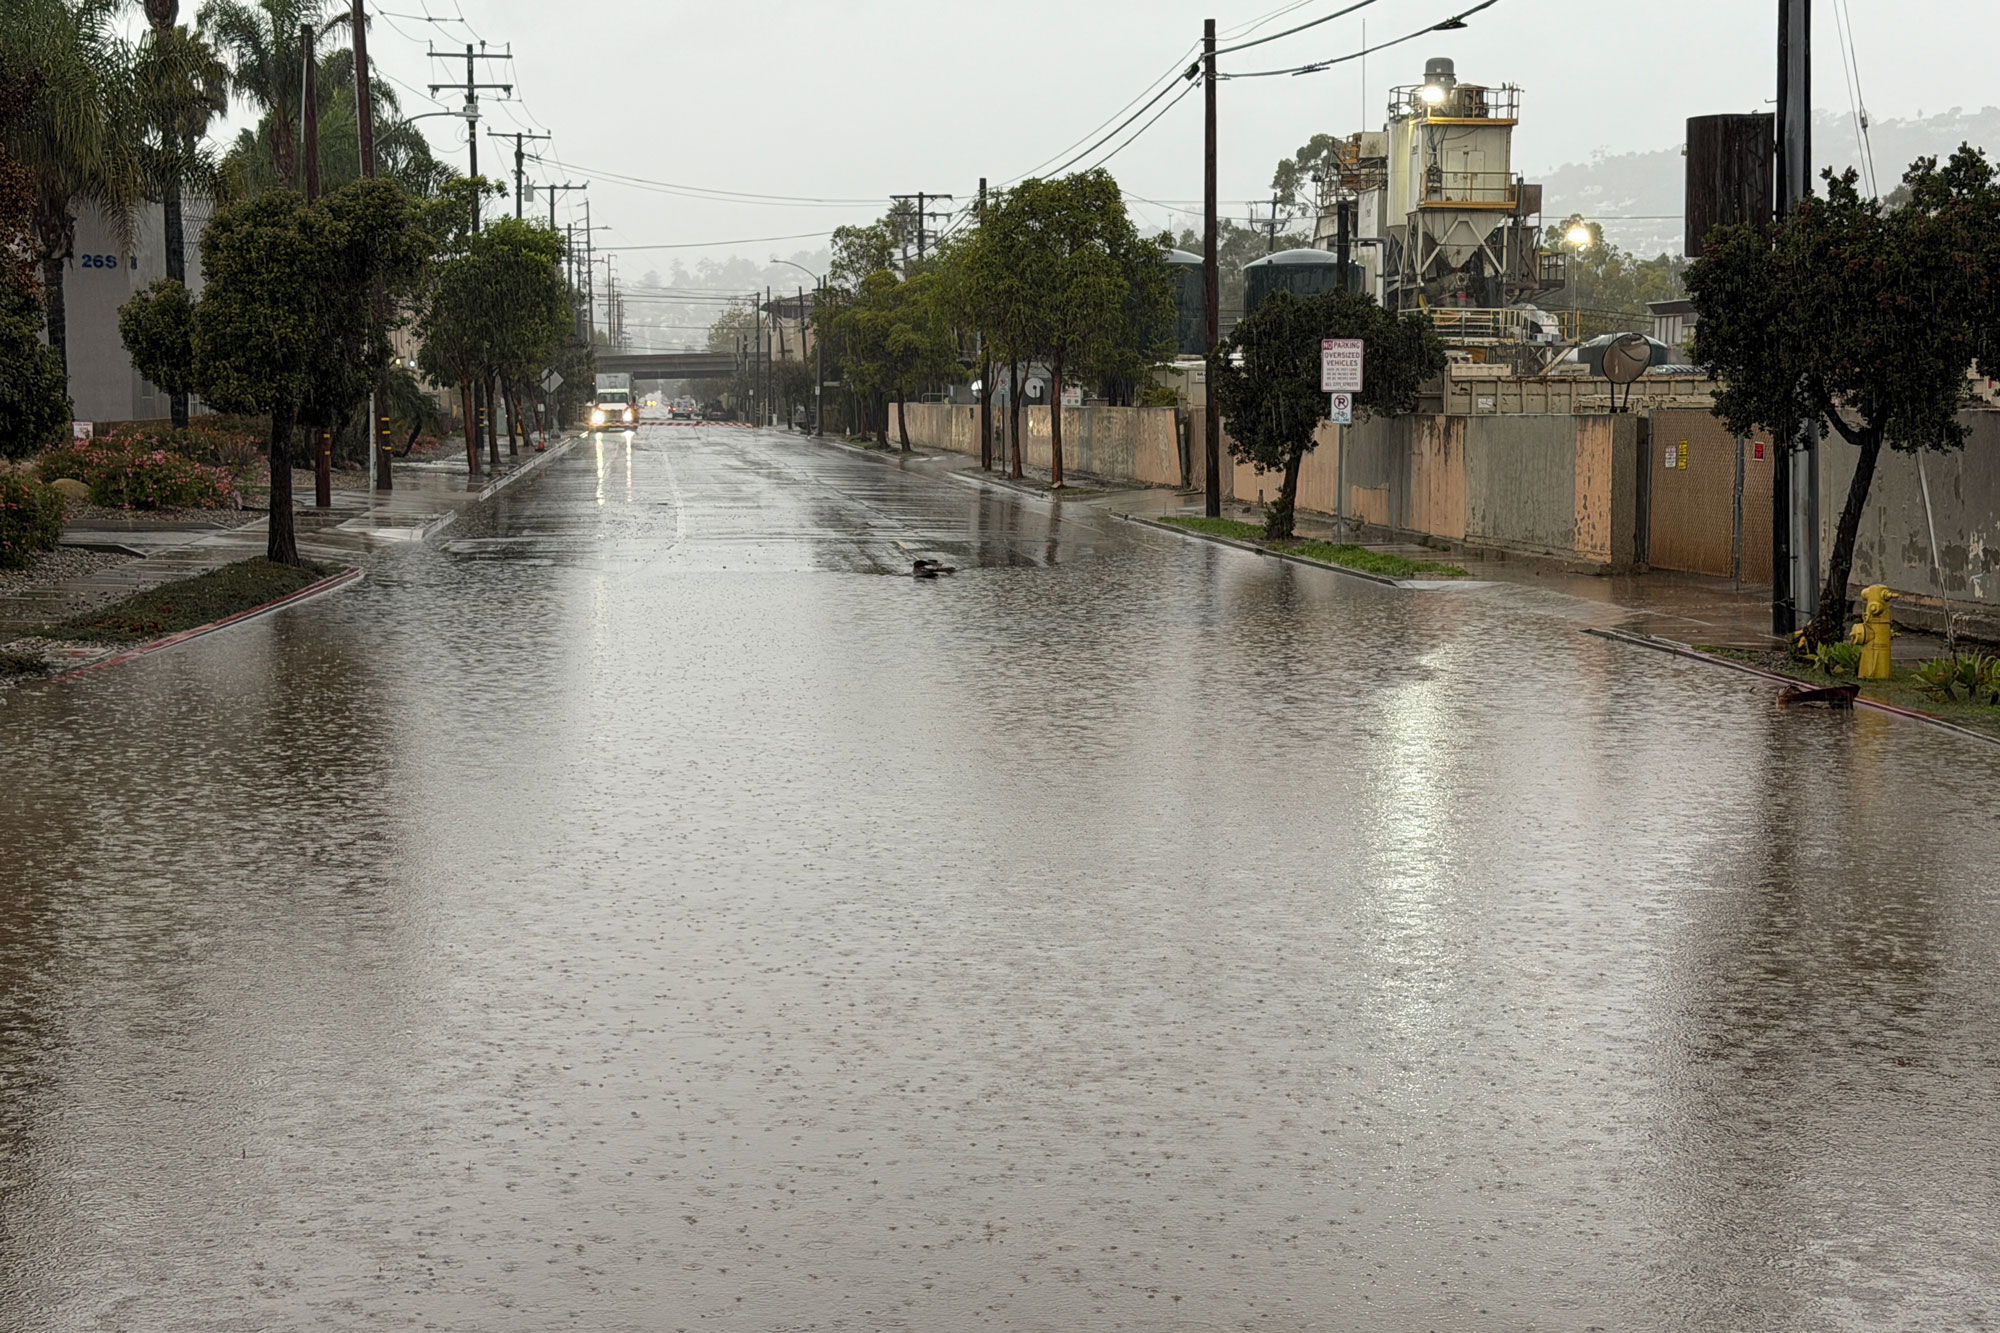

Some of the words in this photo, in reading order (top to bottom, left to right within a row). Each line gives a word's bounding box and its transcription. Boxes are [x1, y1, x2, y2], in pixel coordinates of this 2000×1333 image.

[1323, 341, 1333, 349] NO
[1333, 341, 1361, 349] PARKING
[1326, 359, 1358, 367] VEHICLES
